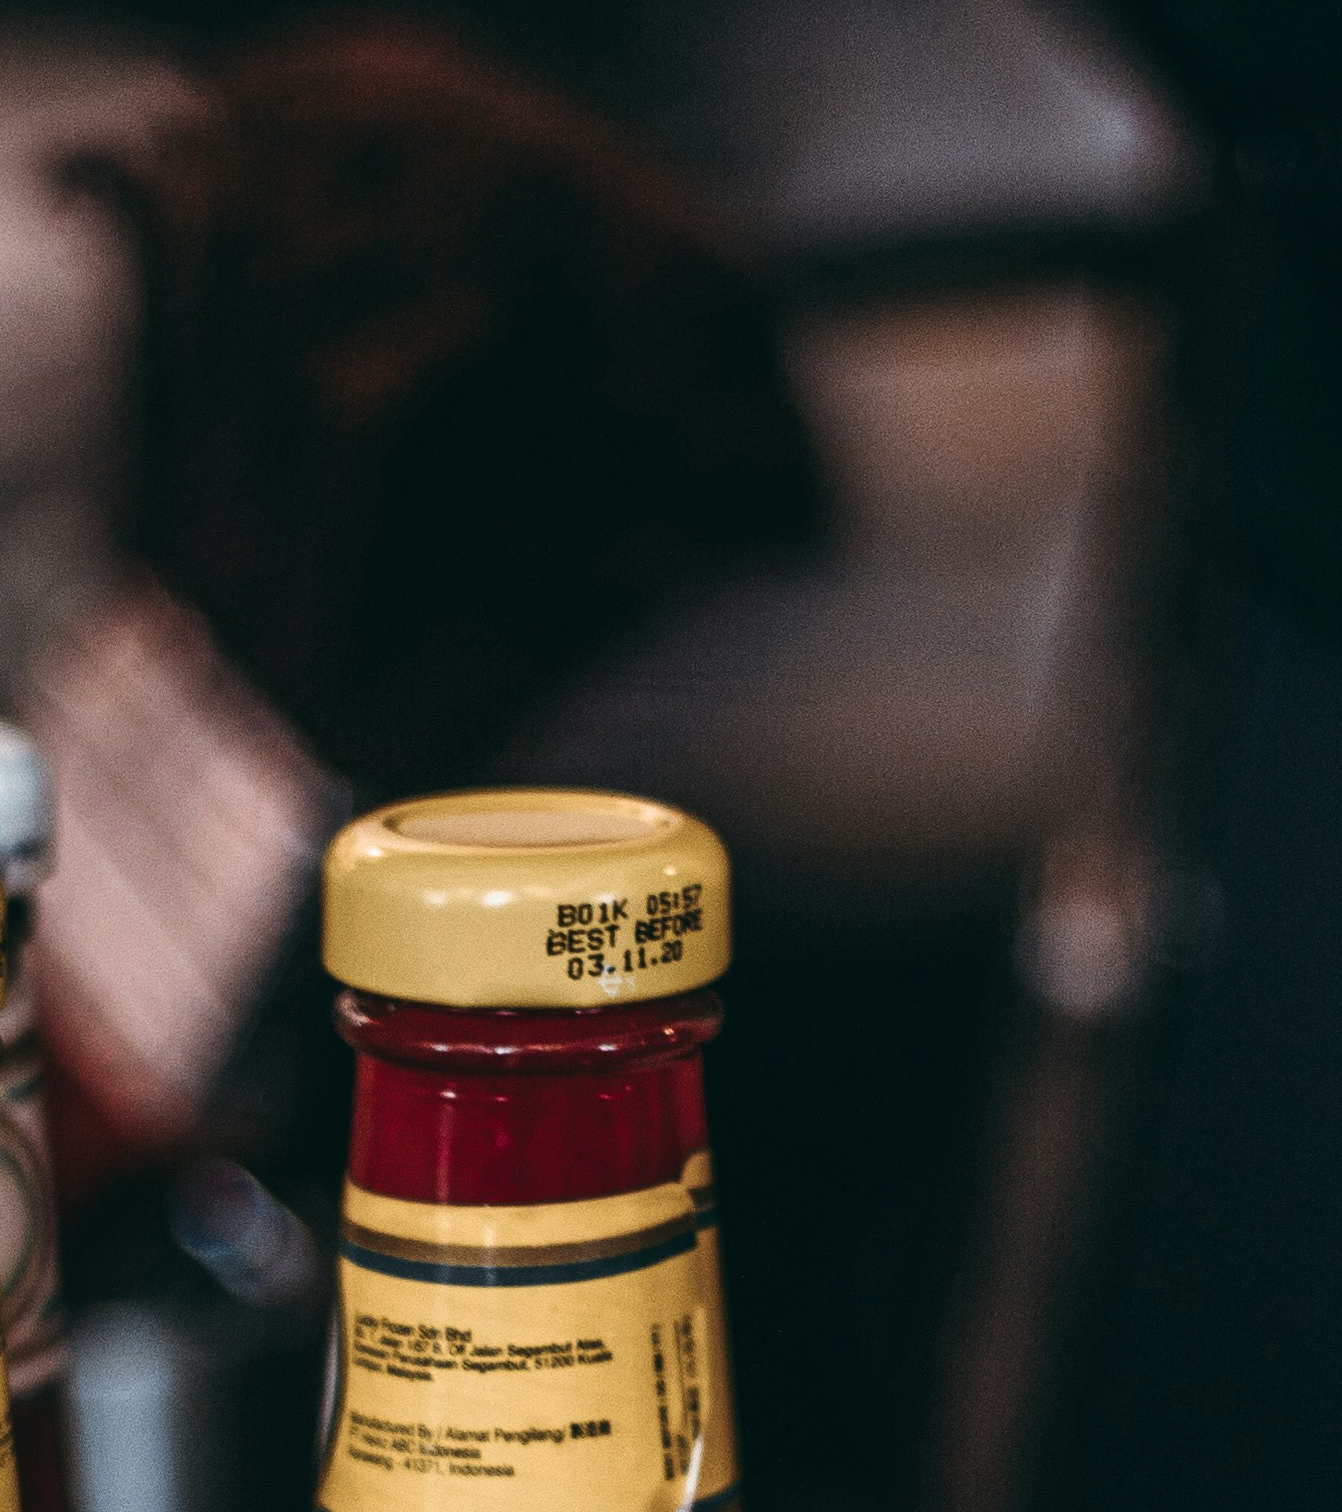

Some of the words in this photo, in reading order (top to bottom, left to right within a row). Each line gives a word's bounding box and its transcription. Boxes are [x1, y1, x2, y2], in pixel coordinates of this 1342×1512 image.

[545, 924, 620, 957] BEST
[635, 907, 704, 944] BEFORE
[567, 939, 684, 981] 03.11.20
